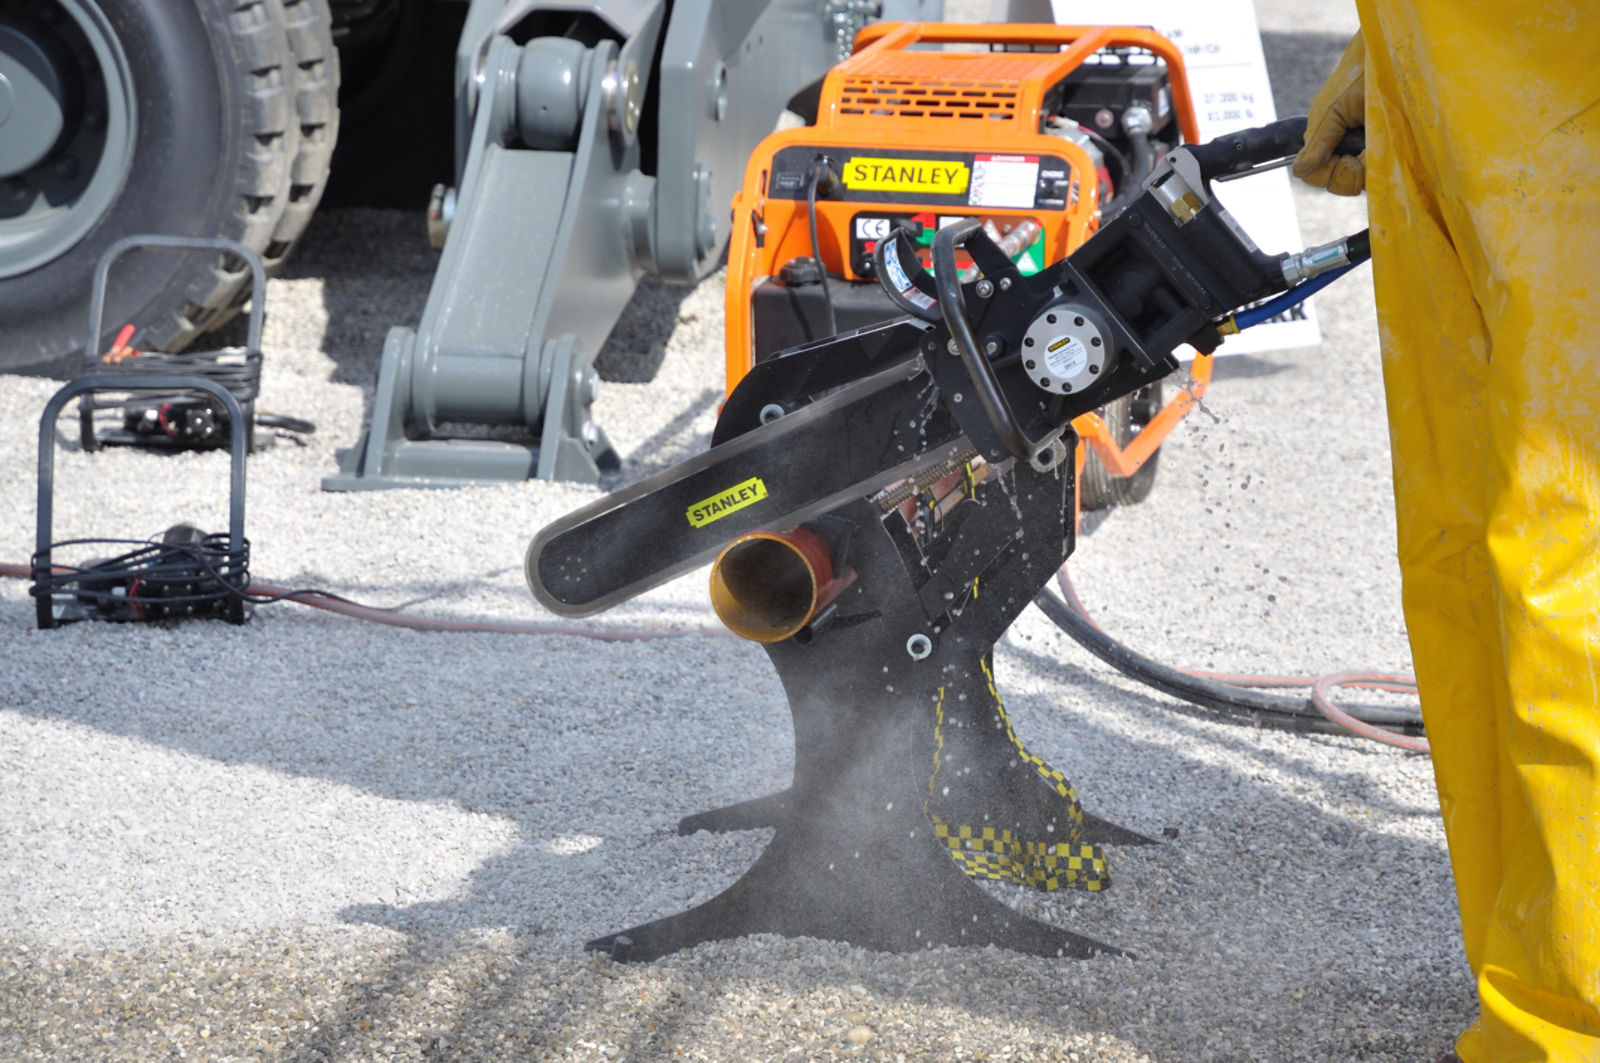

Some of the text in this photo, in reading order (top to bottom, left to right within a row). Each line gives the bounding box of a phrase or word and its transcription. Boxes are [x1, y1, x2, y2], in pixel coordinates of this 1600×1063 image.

[853, 164, 959, 185] STANLEY
[862, 218, 885, 238] CE
[692, 483, 758, 522] STANLEY
